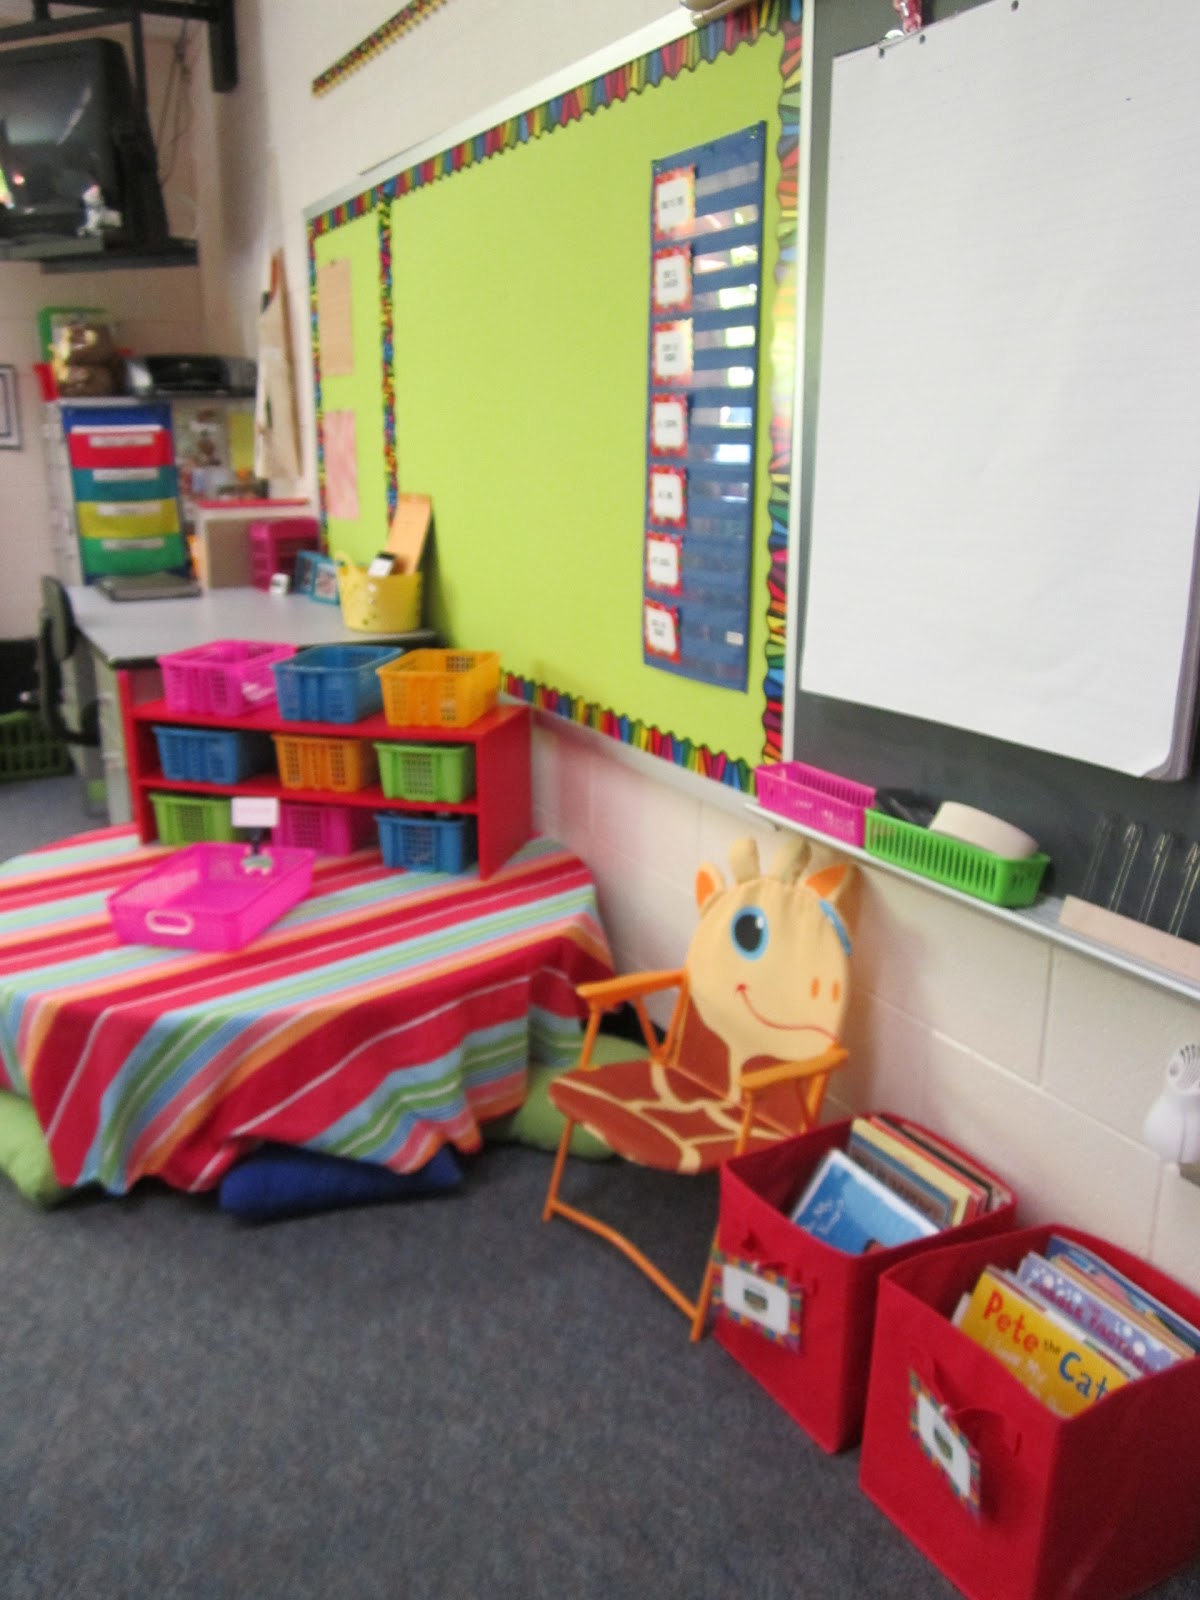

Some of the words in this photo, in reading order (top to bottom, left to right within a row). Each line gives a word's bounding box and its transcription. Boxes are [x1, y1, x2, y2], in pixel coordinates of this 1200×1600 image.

[983, 1289, 1039, 1353] Pete
[1043, 1339, 1061, 1355] the
[1058, 1351, 1107, 1400] Cat
